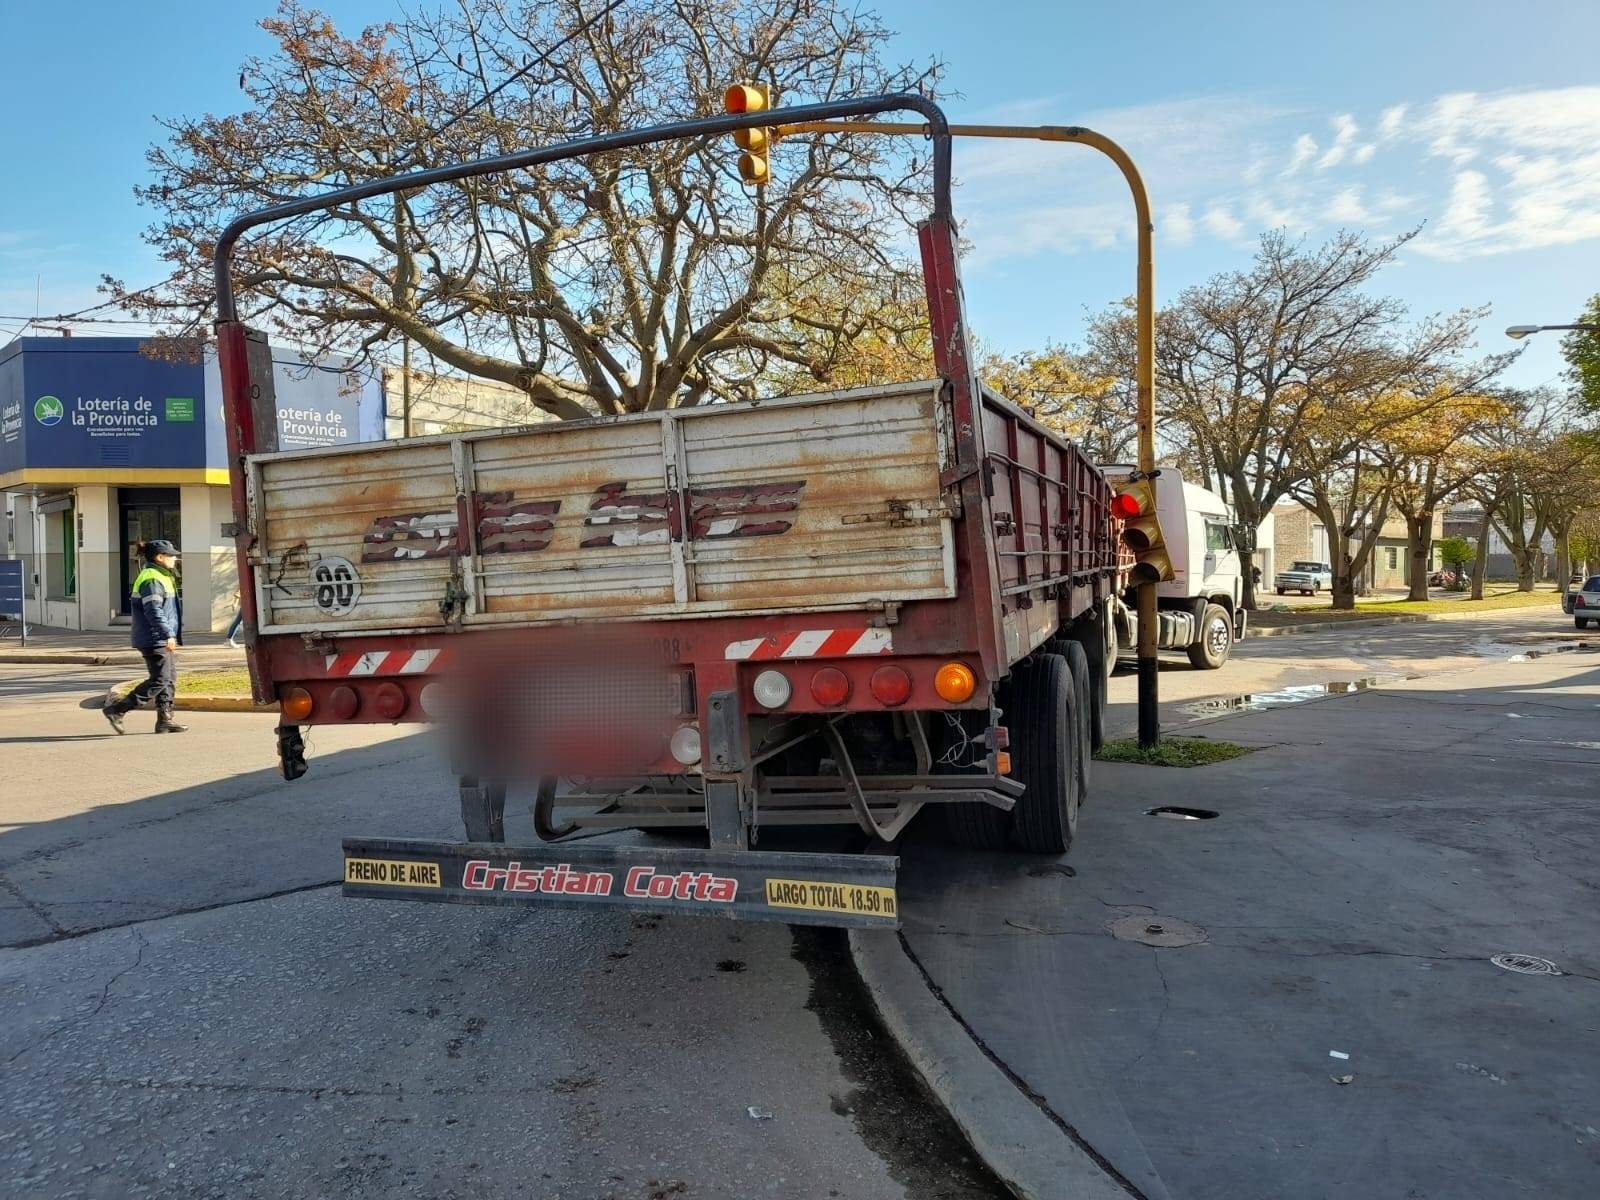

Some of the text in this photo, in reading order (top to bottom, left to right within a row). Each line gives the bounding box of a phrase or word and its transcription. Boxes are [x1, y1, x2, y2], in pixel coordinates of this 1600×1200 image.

[78, 396, 130, 411] Lotería
[134, 396, 152, 411] de
[72, 411, 158, 426] la Provincia
[277, 408, 342, 424] otería de
[283, 419, 347, 438] Provincia
[316, 565, 353, 608] 80
[349, 861, 437, 884] FRENO DE AIRE
[462, 859, 738, 902] Cristian Cotta
[768, 882, 895, 914] LARGO TOTAL 18.50 m
